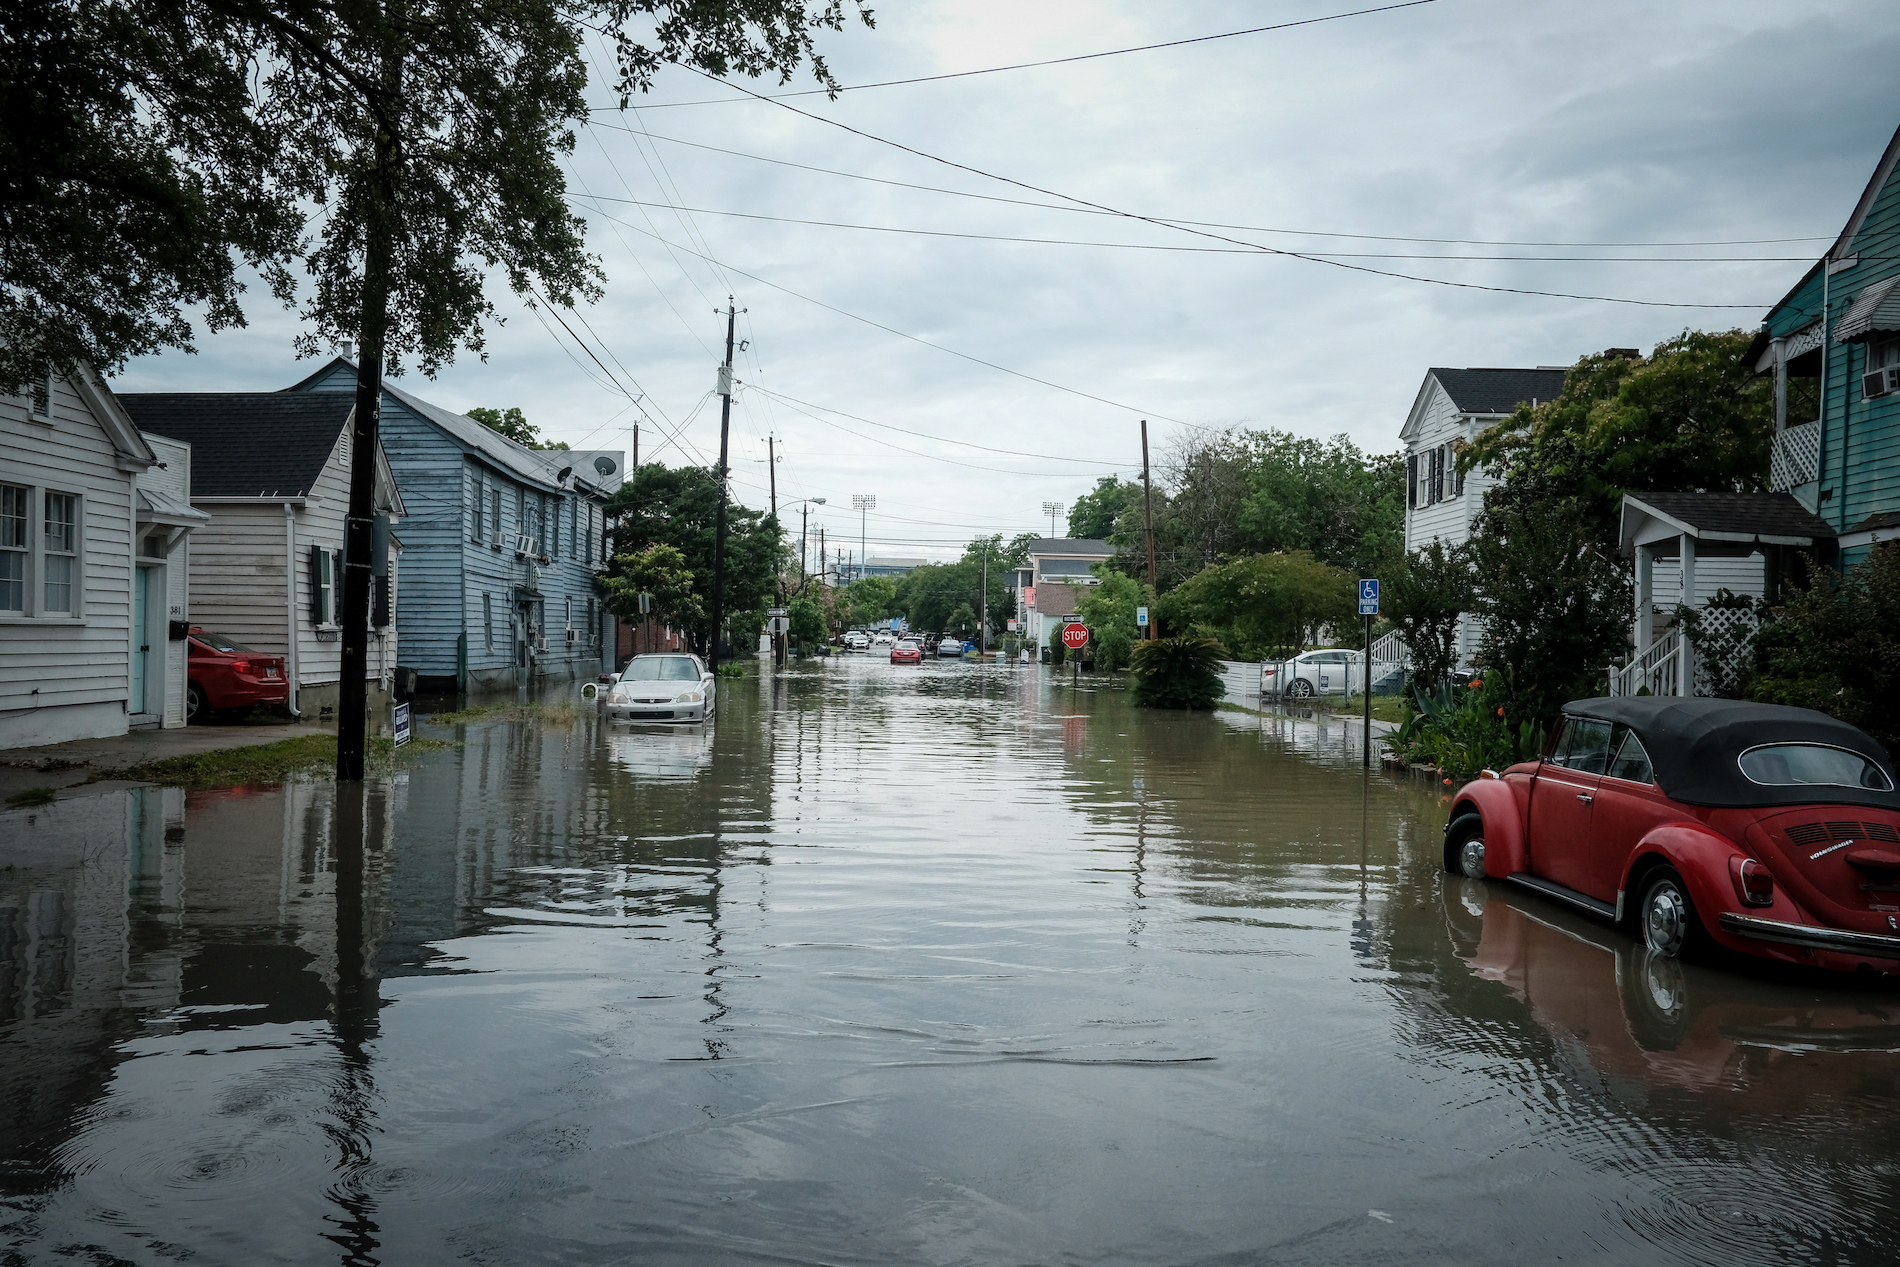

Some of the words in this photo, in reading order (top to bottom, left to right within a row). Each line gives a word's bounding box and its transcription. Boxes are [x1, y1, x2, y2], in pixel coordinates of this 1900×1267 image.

[1360, 598, 1378, 606] PARKING
[1363, 605, 1374, 613] ONLY
[1064, 630, 1087, 641] STOP
[1809, 839, 1854, 860] VOLKSWAGEN
